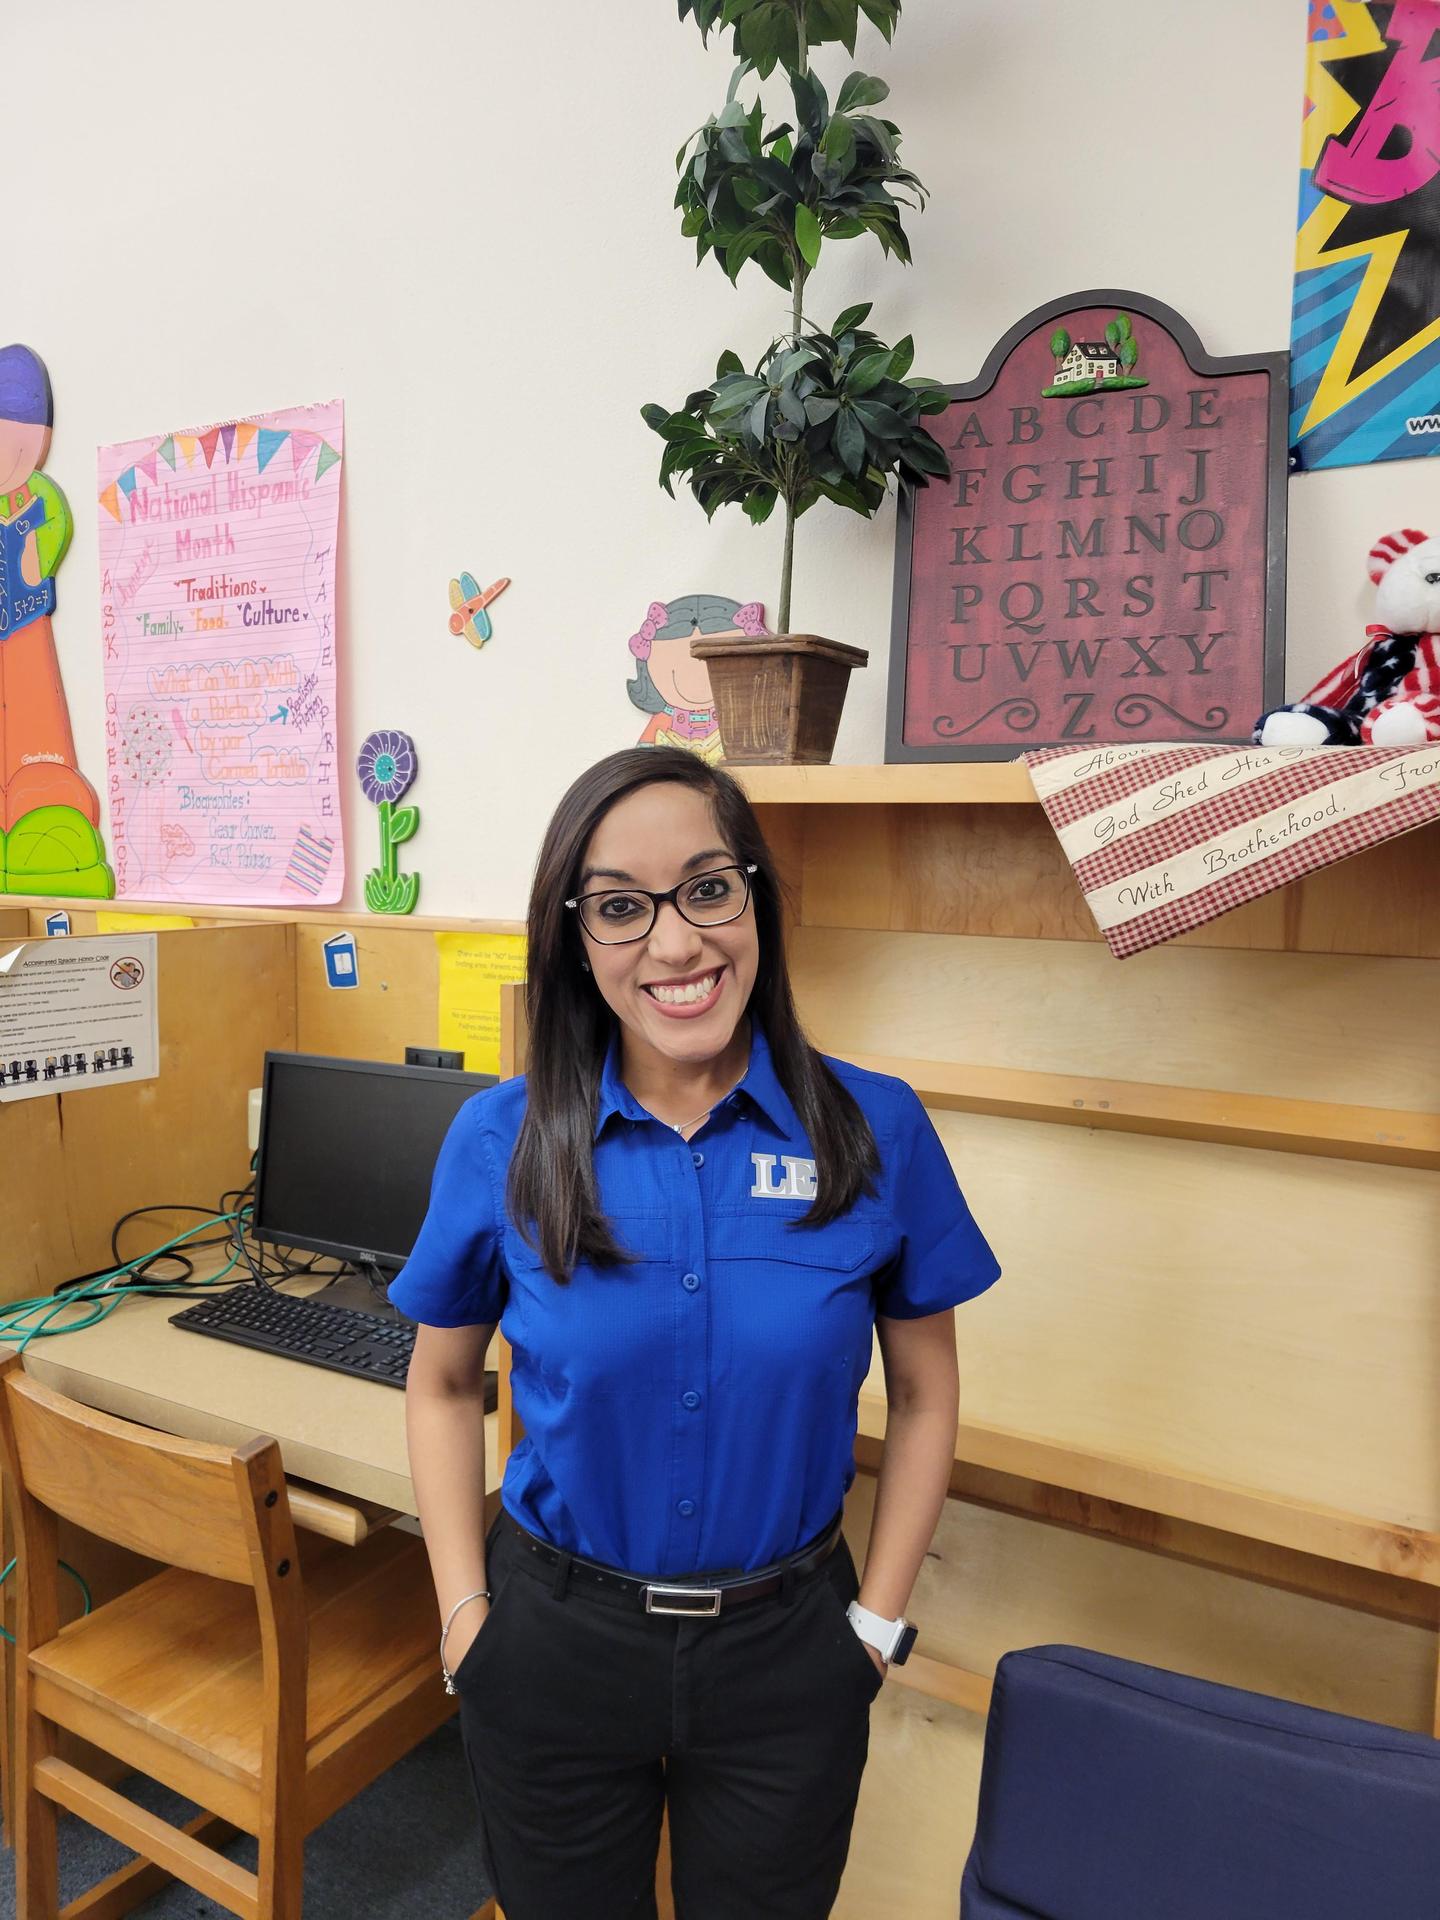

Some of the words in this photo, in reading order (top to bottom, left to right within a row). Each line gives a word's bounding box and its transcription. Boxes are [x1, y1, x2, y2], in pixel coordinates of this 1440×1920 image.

[130, 474, 217, 524] National
[228, 471, 310, 519] Hispanic
[176, 523, 235, 563] Month
[14, 589, 49, 621] 5+2=7
[181, 574, 257, 602] Traditions
[143, 611, 180, 641] Family
[243, 599, 300, 627] Culture
[1094, 803, 1141, 844] God
[1153, 772, 1208, 811] Shed
[1222, 755, 1272, 781] His
[1118, 873, 1175, 907] With
[1202, 795, 1347, 875] Brotherhood.
[1379, 760, 1440, 791] Fro
[750, 1152, 818, 1200] LE
